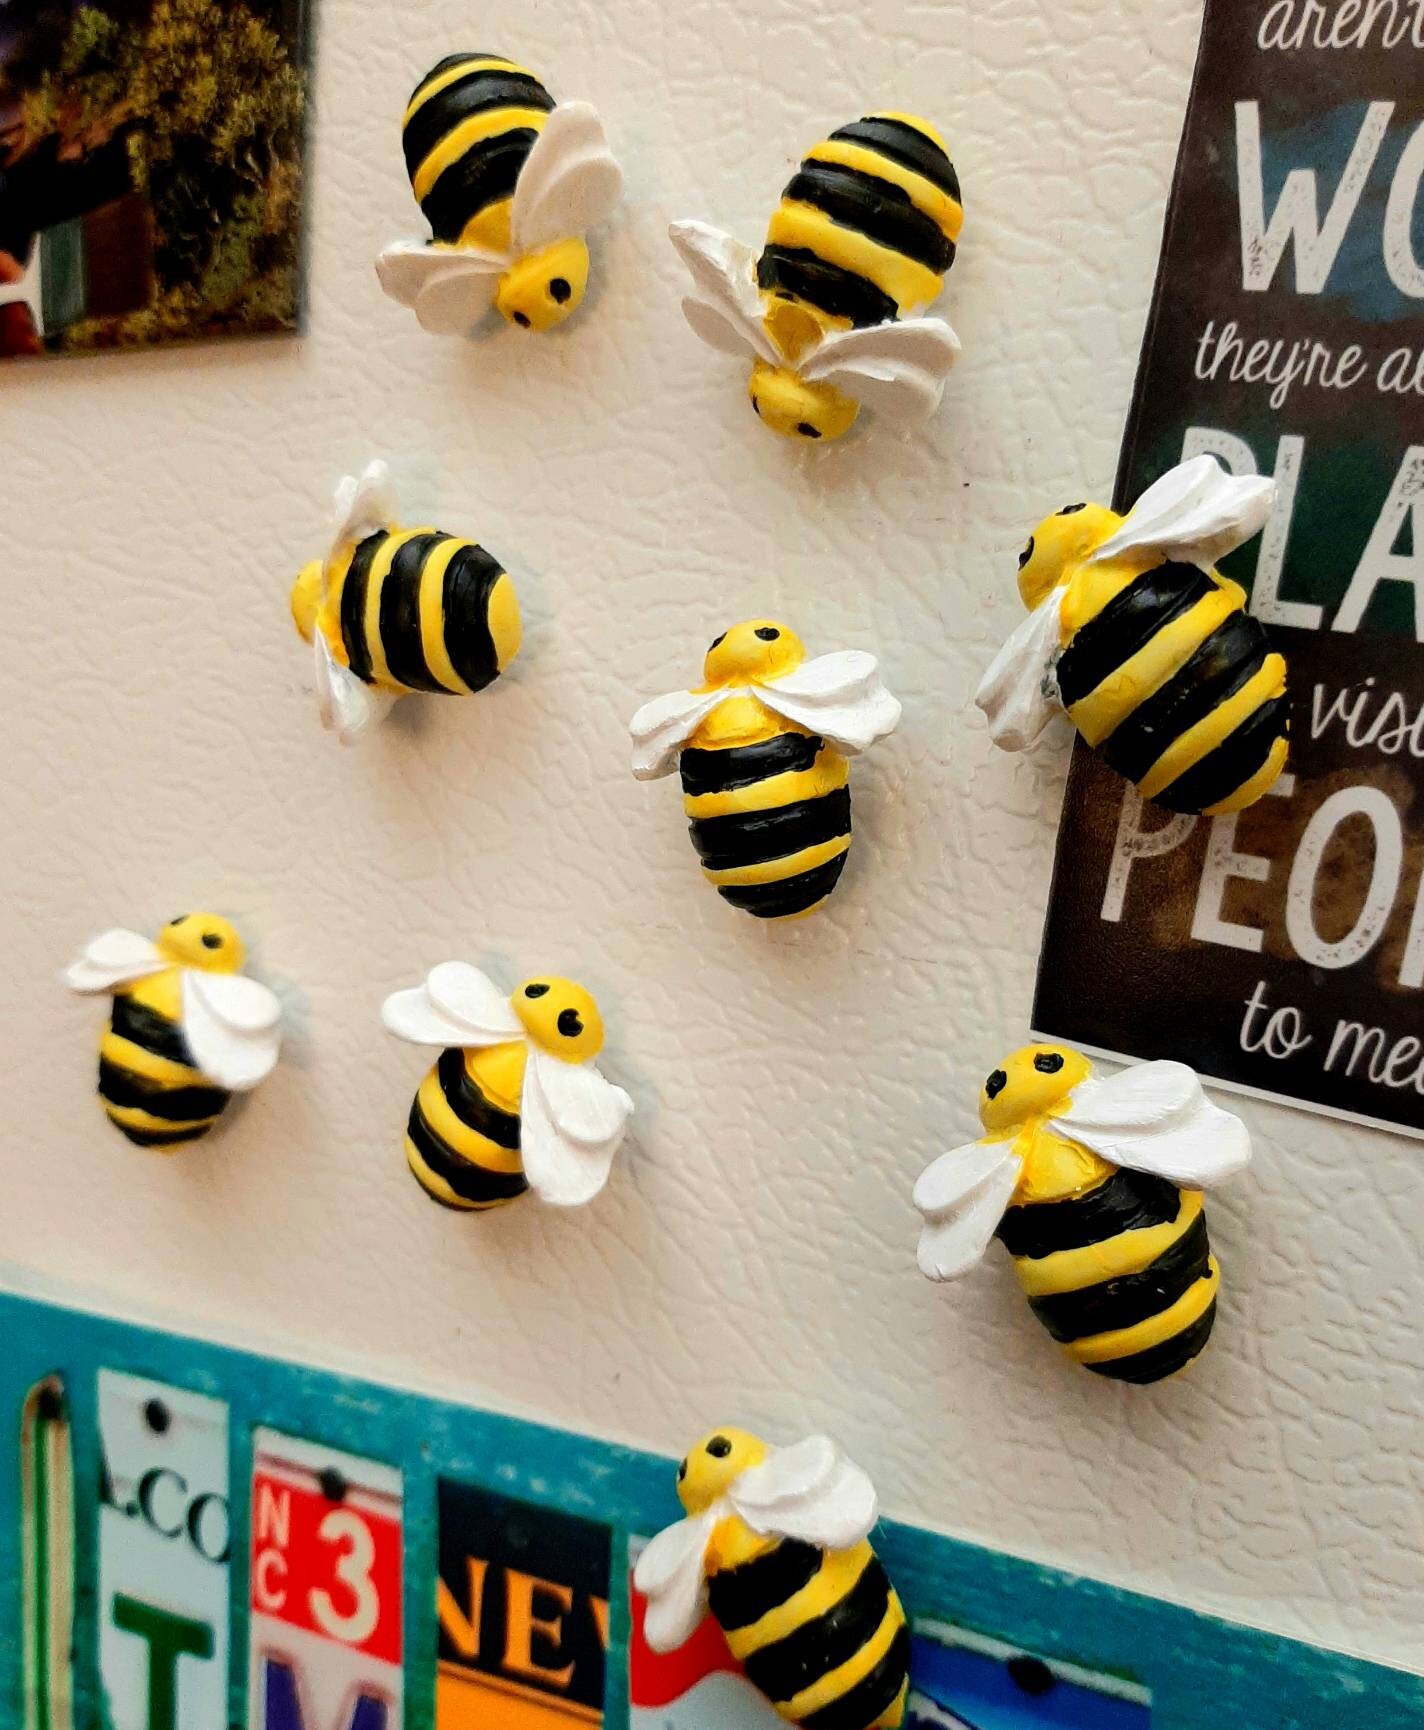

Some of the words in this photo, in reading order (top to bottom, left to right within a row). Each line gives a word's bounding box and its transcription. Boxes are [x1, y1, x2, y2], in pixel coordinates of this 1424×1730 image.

[1194, 320, 1368, 409] they're
[1239, 980, 1312, 1060] to
[438, 1555, 609, 1689] NE
